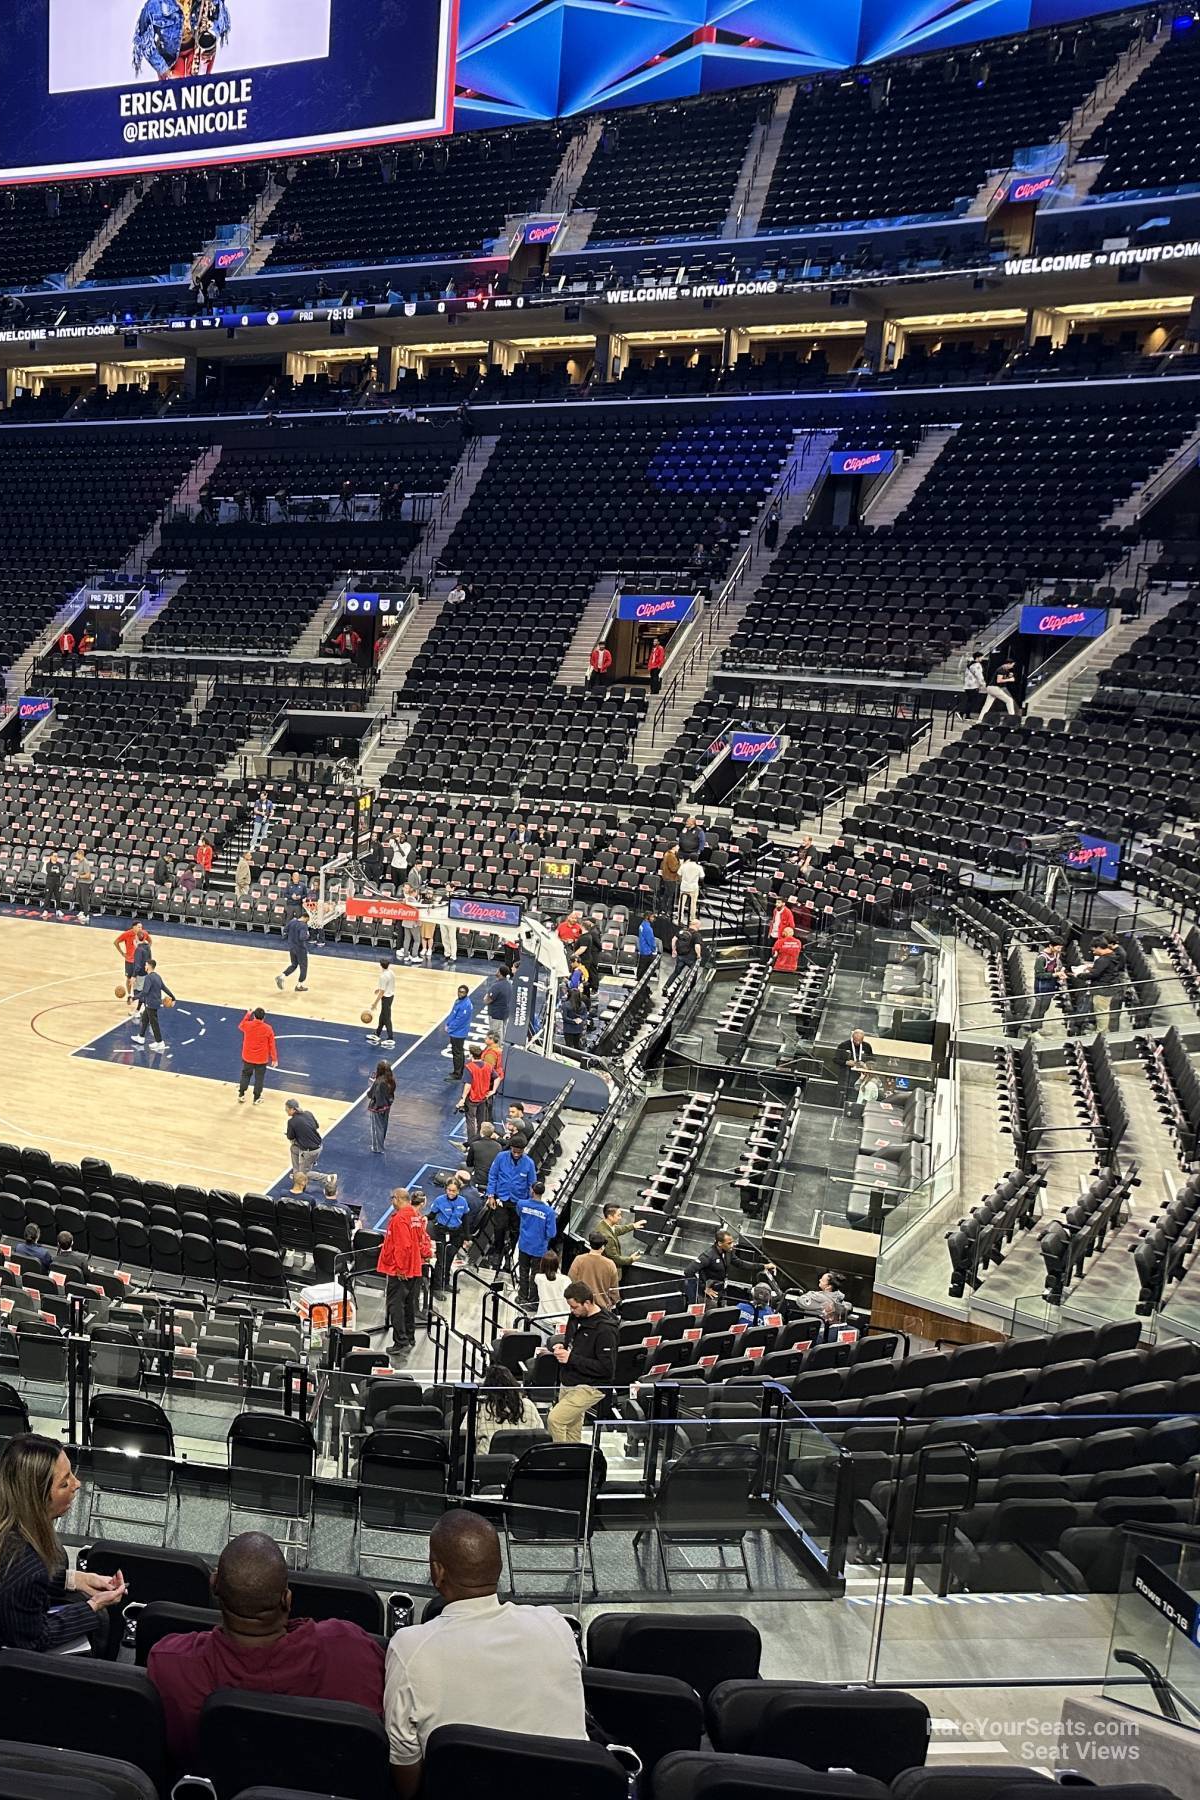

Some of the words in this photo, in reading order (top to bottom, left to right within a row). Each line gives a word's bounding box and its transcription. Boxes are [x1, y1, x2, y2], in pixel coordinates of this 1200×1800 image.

[119, 88, 177, 117] ERISA
[181, 78, 252, 110] NICOLE
[123, 108, 248, 143] @ERISANICOLE
[1004, 253, 1093, 276] WELCOME
[1109, 246, 1162, 266] INTUIT
[606, 287, 678, 304] WELCOME
[692, 283, 735, 299] INTUIT
[56, 327, 86, 338] INTUIT
[843, 453, 881, 471] Clippers
[636, 600, 676, 617] Clippers
[1039, 612, 1086, 631] Clippers
[733, 740, 777, 757] Clippers
[460, 902, 506, 919] Clippers
[1135, 1575, 1162, 1608] Rows
[1162, 1601, 1189, 1631] 10-16
